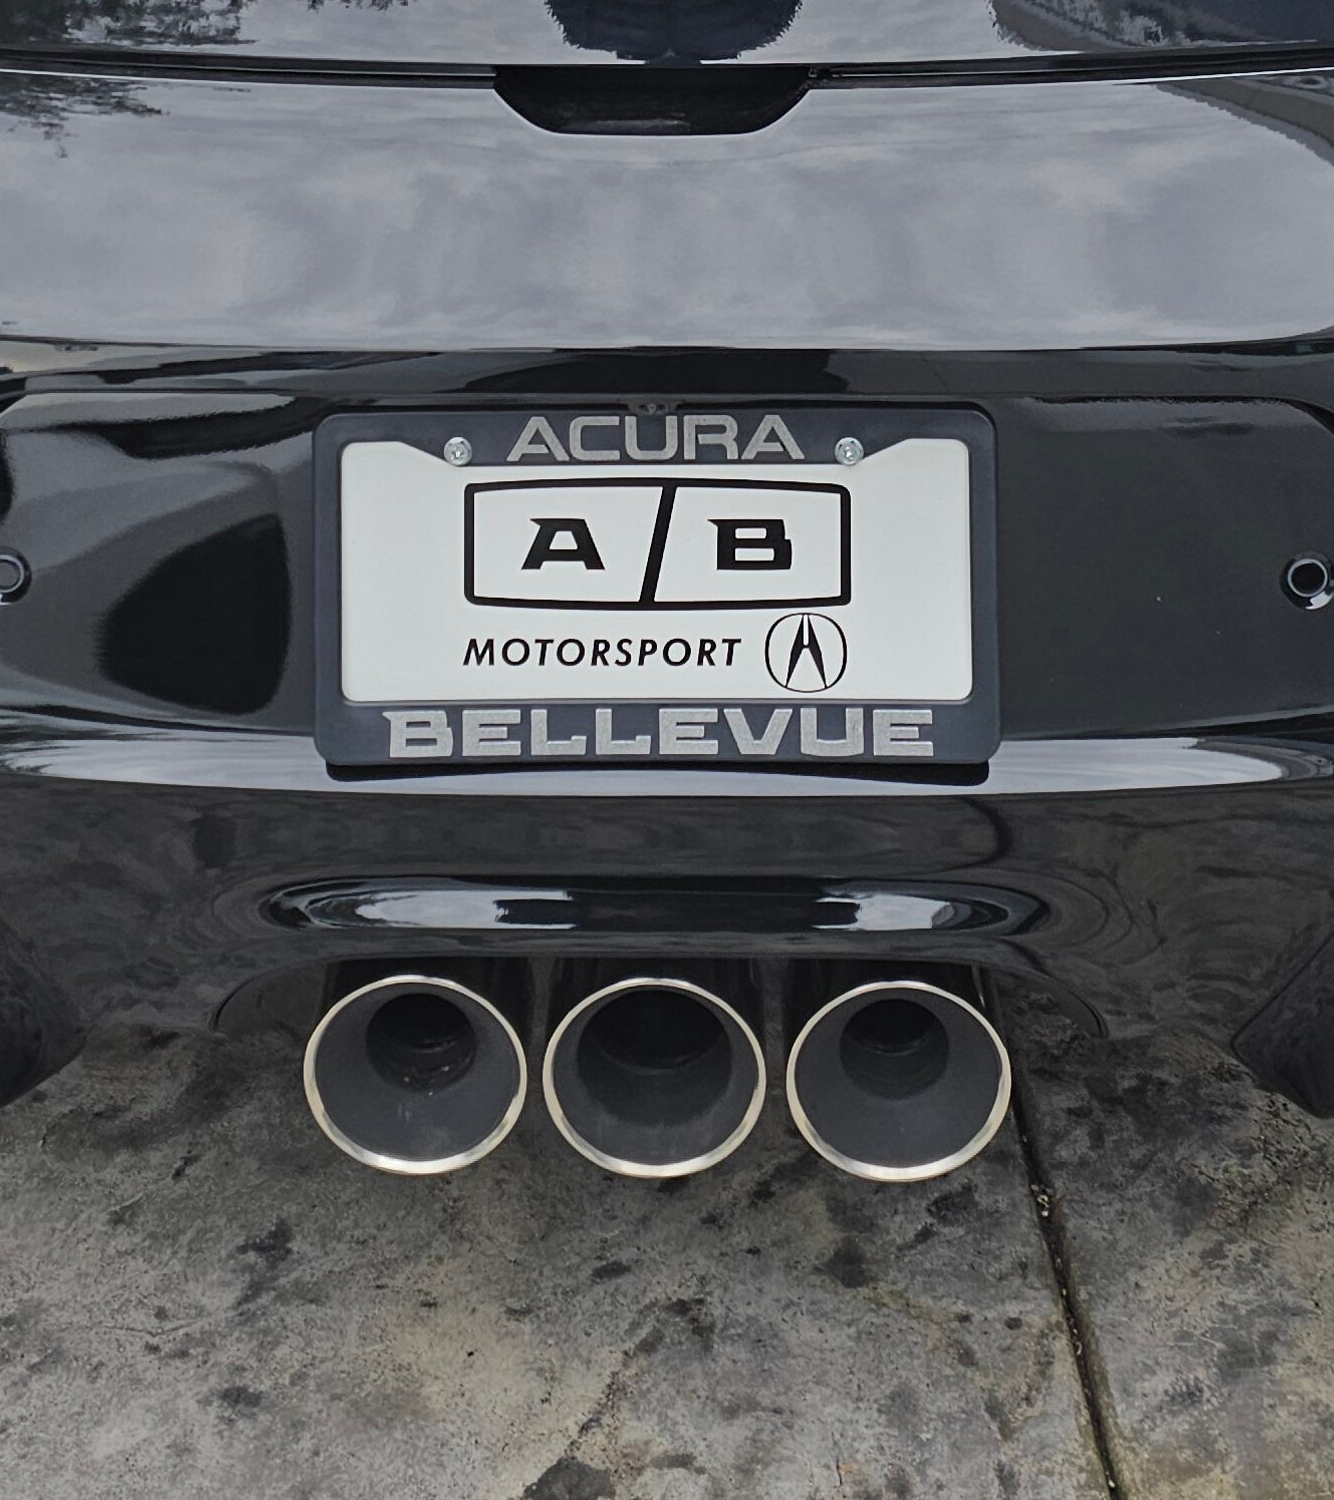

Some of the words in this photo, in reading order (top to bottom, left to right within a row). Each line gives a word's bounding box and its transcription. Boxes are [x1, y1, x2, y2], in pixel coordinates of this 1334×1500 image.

[506, 413, 806, 462] ACURA
[463, 636, 743, 667] MOTORSPORT
[381, 706, 935, 758] BELLEVUE
